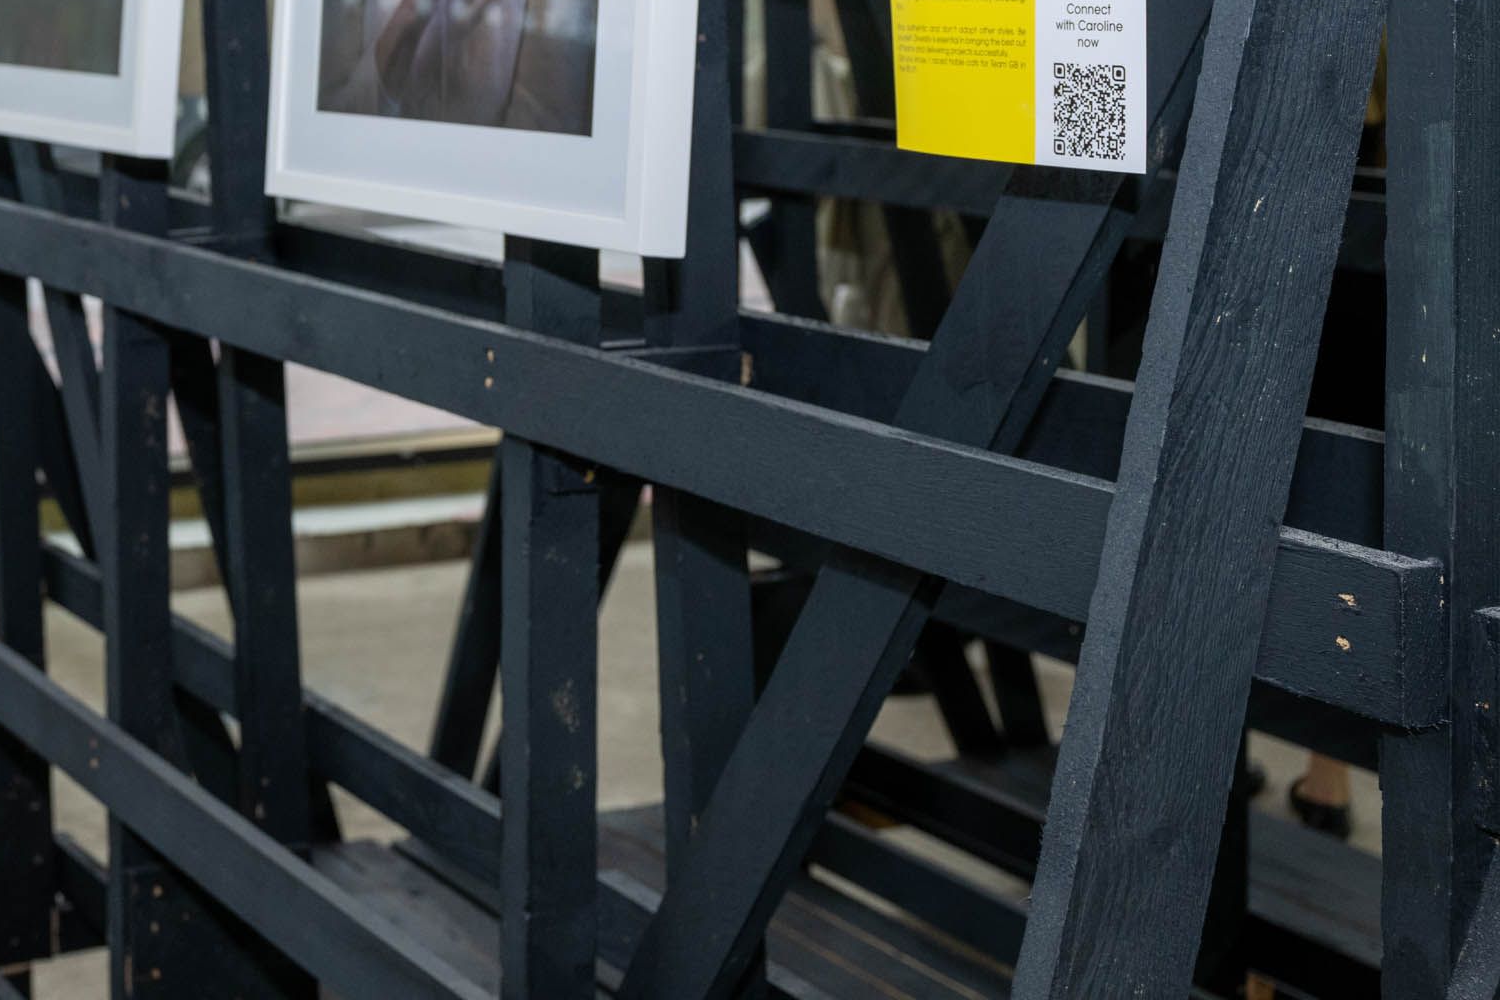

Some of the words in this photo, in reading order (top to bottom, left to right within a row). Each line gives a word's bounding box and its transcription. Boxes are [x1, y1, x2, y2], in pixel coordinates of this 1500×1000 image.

[1066, 3, 1111, 15] Connect
[1056, 20, 1075, 31] with
[1078, 19, 1123, 32] Caroline
[1077, 37, 1099, 48] now
